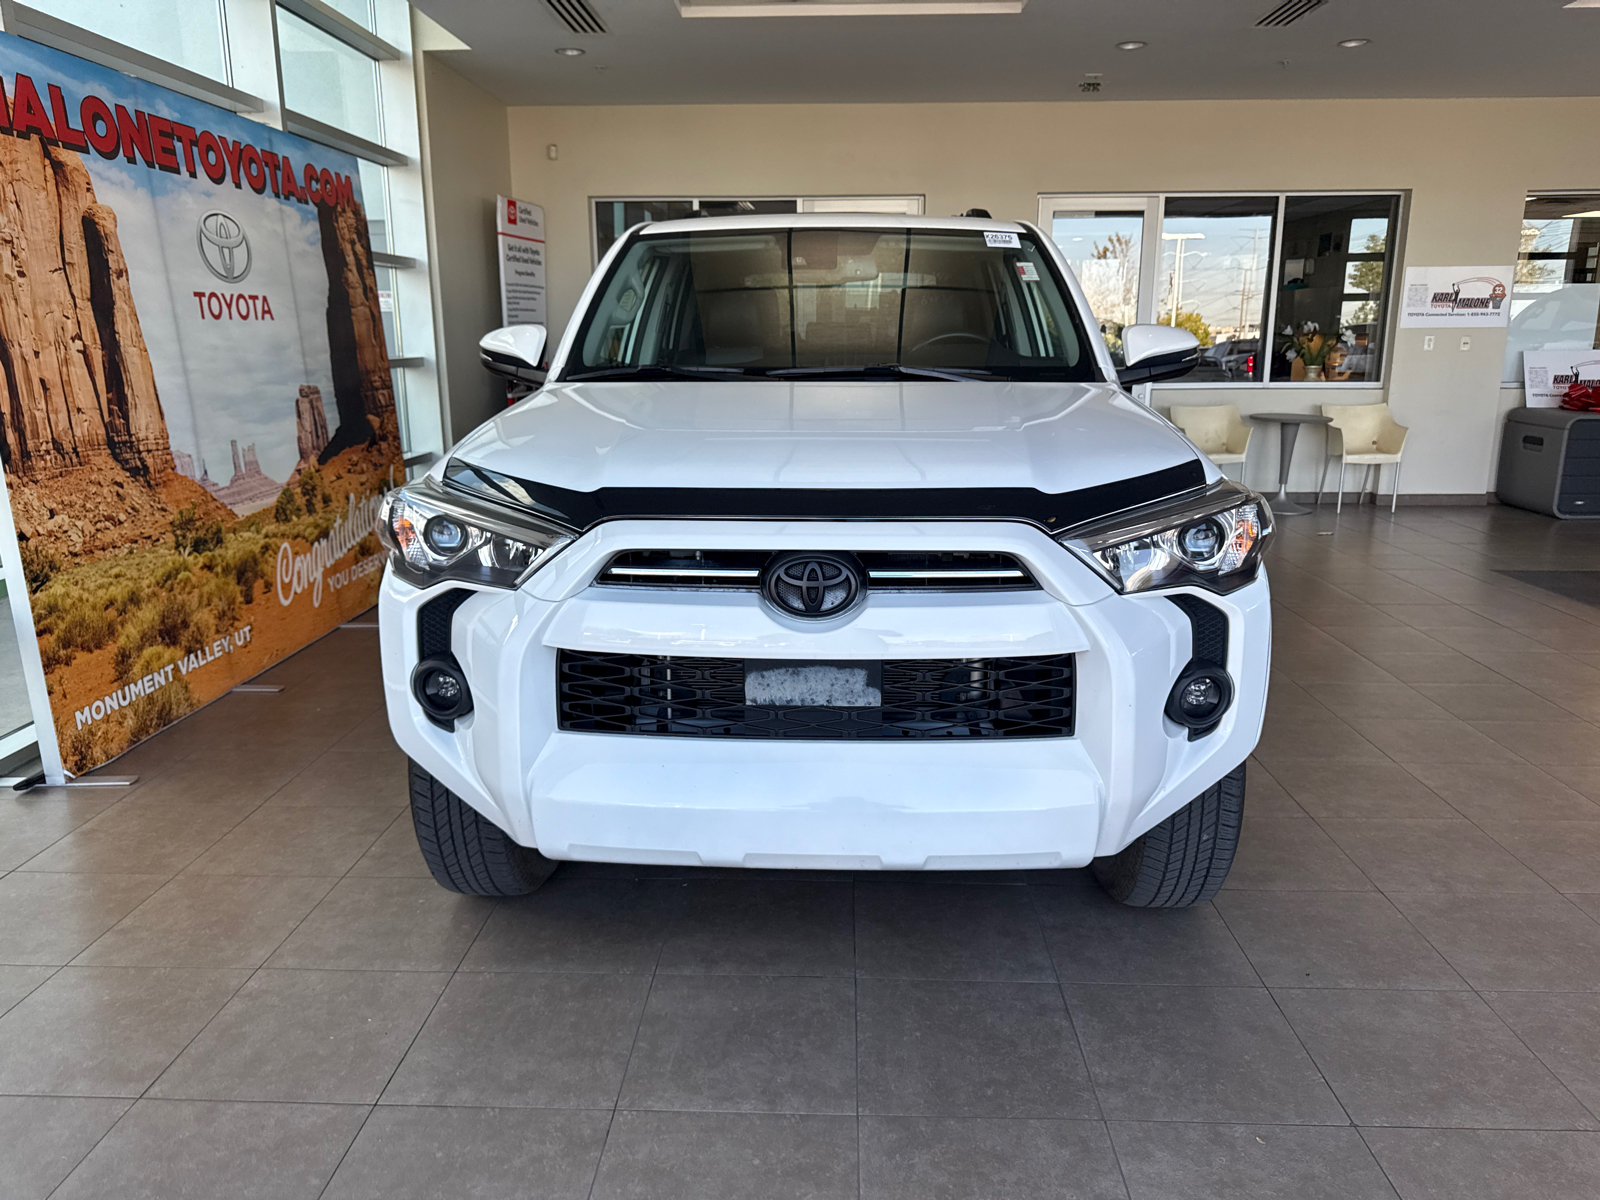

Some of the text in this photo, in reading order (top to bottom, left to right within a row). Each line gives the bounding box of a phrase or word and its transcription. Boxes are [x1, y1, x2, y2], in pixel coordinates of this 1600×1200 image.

[193, 291, 275, 321] TOYOTA
[1431, 292, 1491, 309] KARL MALONE
[1553, 375, 1574, 384] KARL
[327, 550, 388, 593] YOU DESERV
[74, 625, 251, 730] MONUMENT VALLEY, UT
